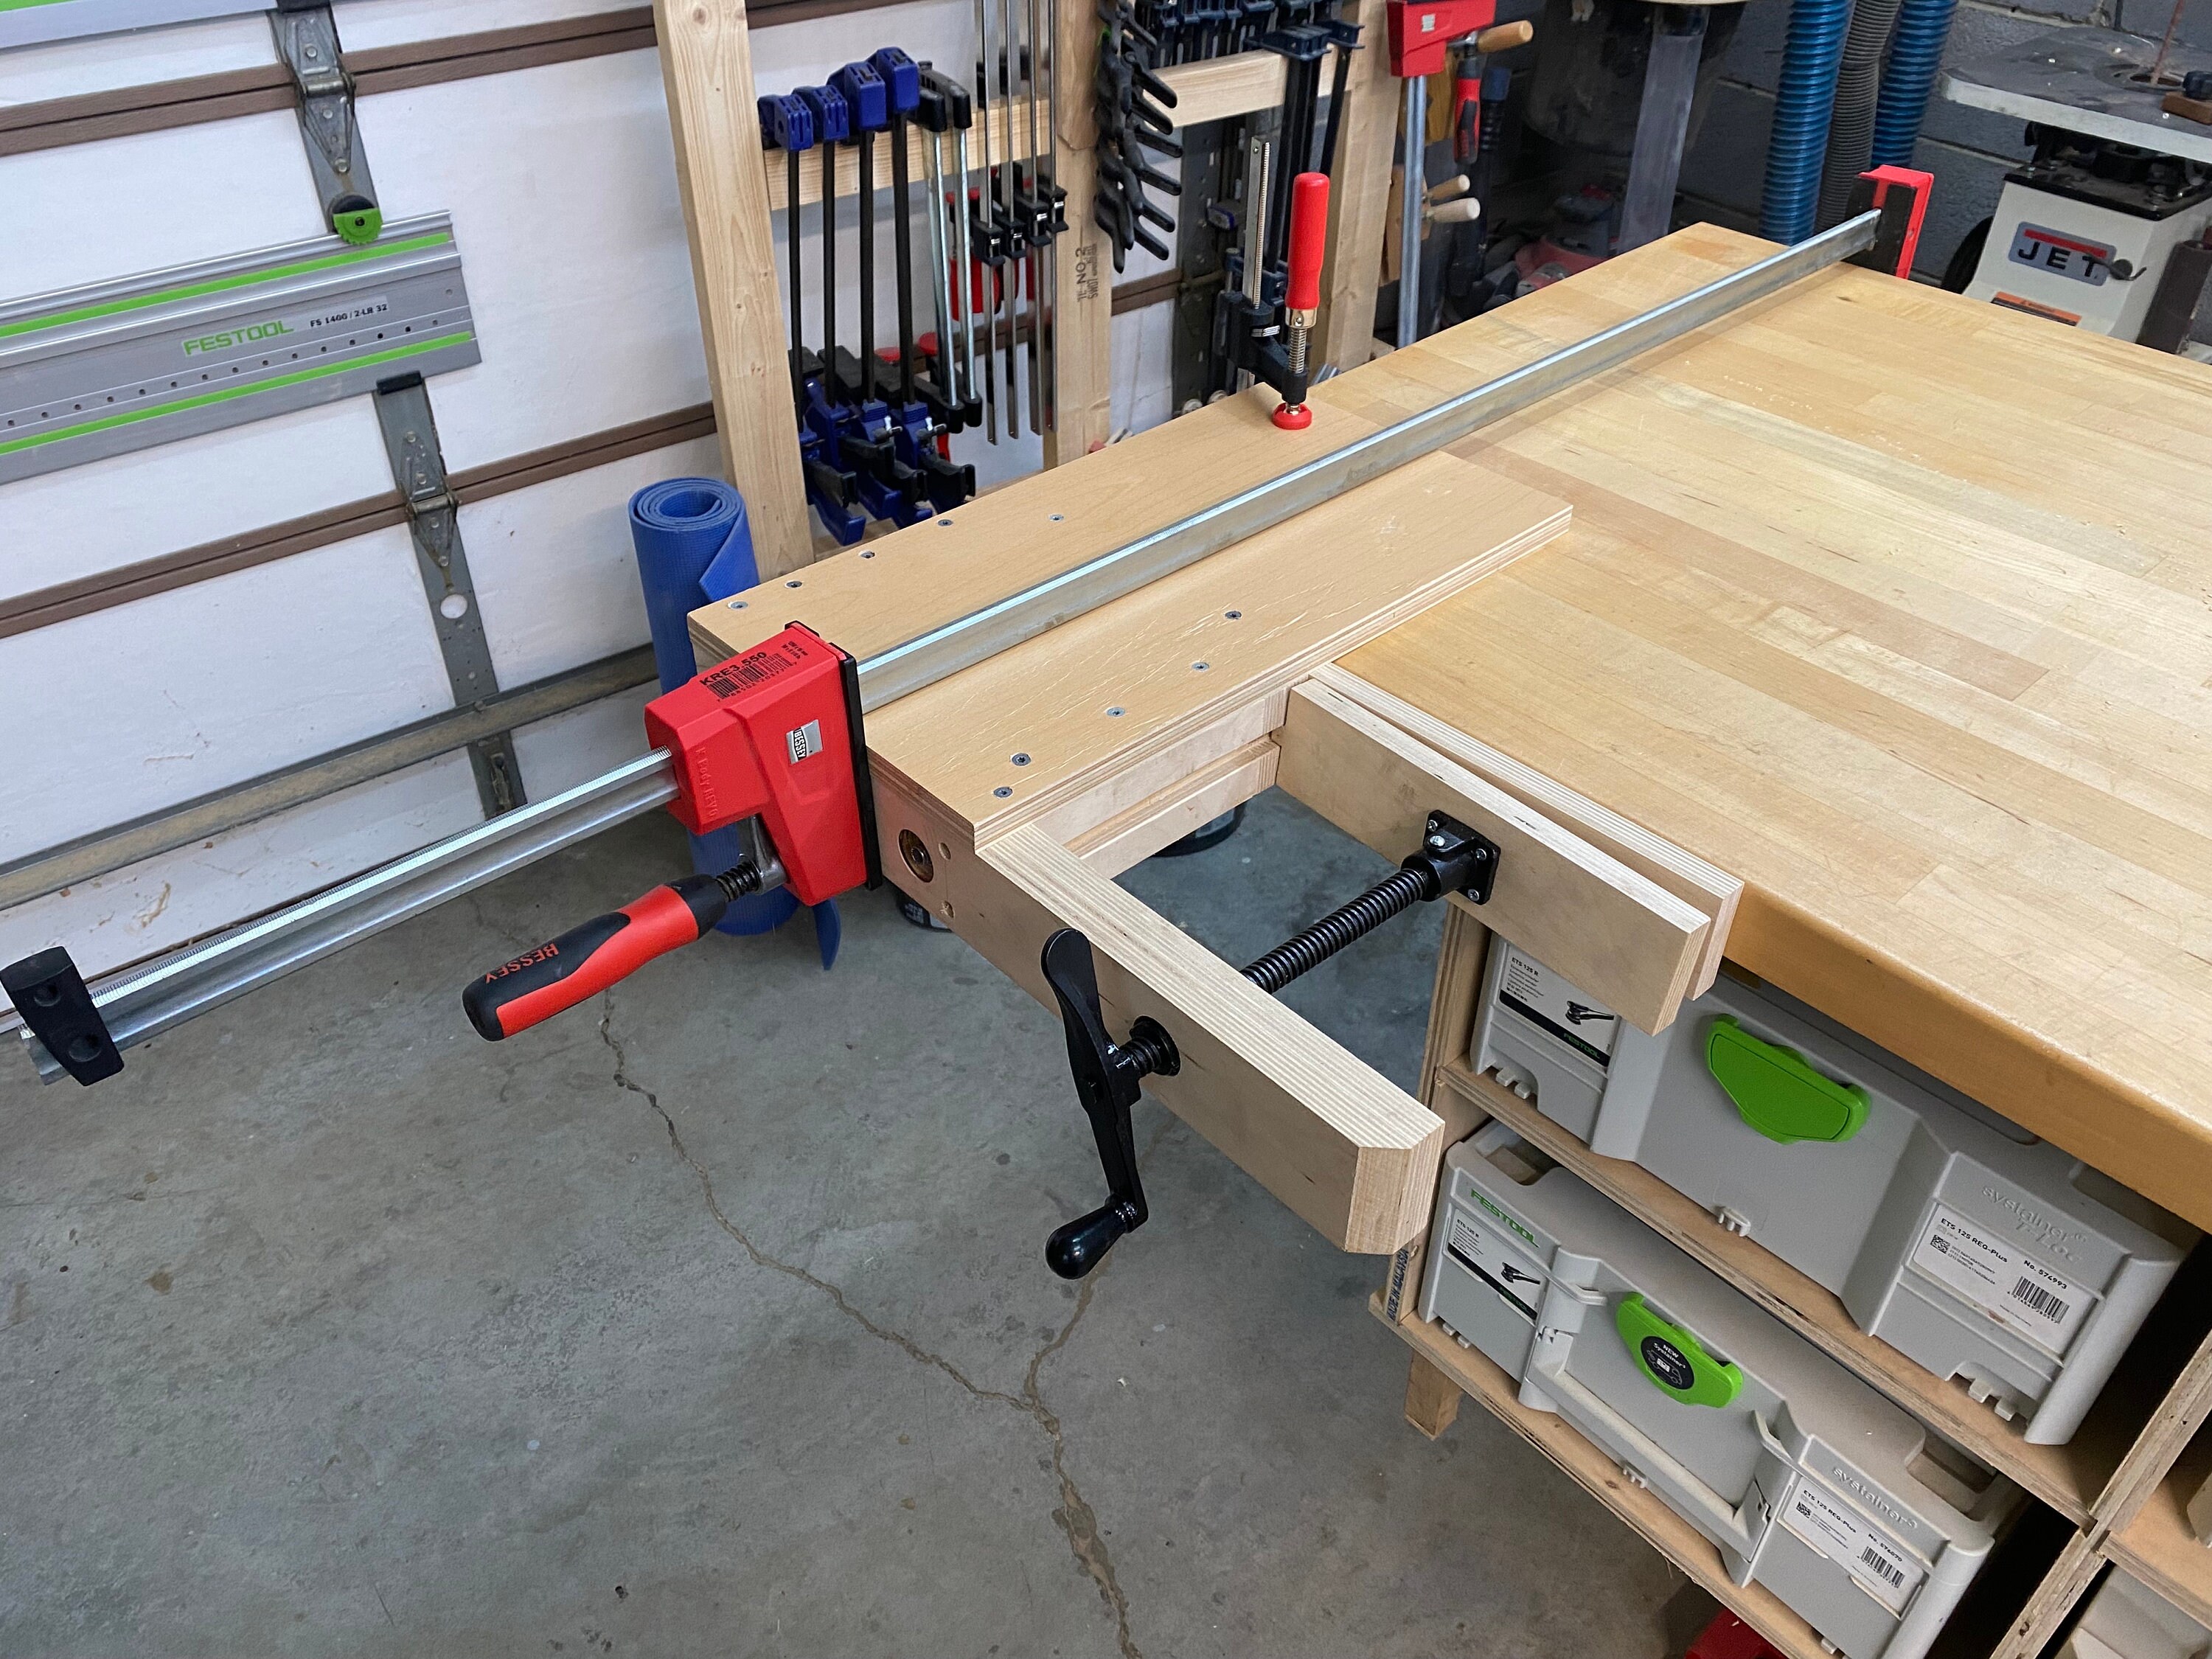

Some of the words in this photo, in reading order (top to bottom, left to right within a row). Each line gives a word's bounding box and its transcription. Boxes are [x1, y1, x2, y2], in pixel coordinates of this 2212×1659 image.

[2017, 241, 2098, 278] JET
[184, 320, 295, 355] FESTOOL
[310, 319, 322, 327] FS
[324, 313, 348, 324] 1400
[376, 303, 388, 312] 32
[699, 652, 768, 686] KRE3.550
[794, 729, 806, 758] BESSEY
[485, 943, 560, 984] BESSEY
[1512, 957, 1523, 967] ETS
[1523, 964, 1534, 973] 125
[1470, 1188, 1540, 1248] FESTOOL
[1941, 1218, 1956, 1230] ETS
[1958, 1228, 1971, 1239] 125
[1972, 1237, 2008, 1263] REQ-Plus
[2023, 1259, 2037, 1271] No.
[1663, 1344, 1679, 1358] NEW
[1804, 1489, 1815, 1500] ETS
[1817, 1500, 1827, 1510] 125
